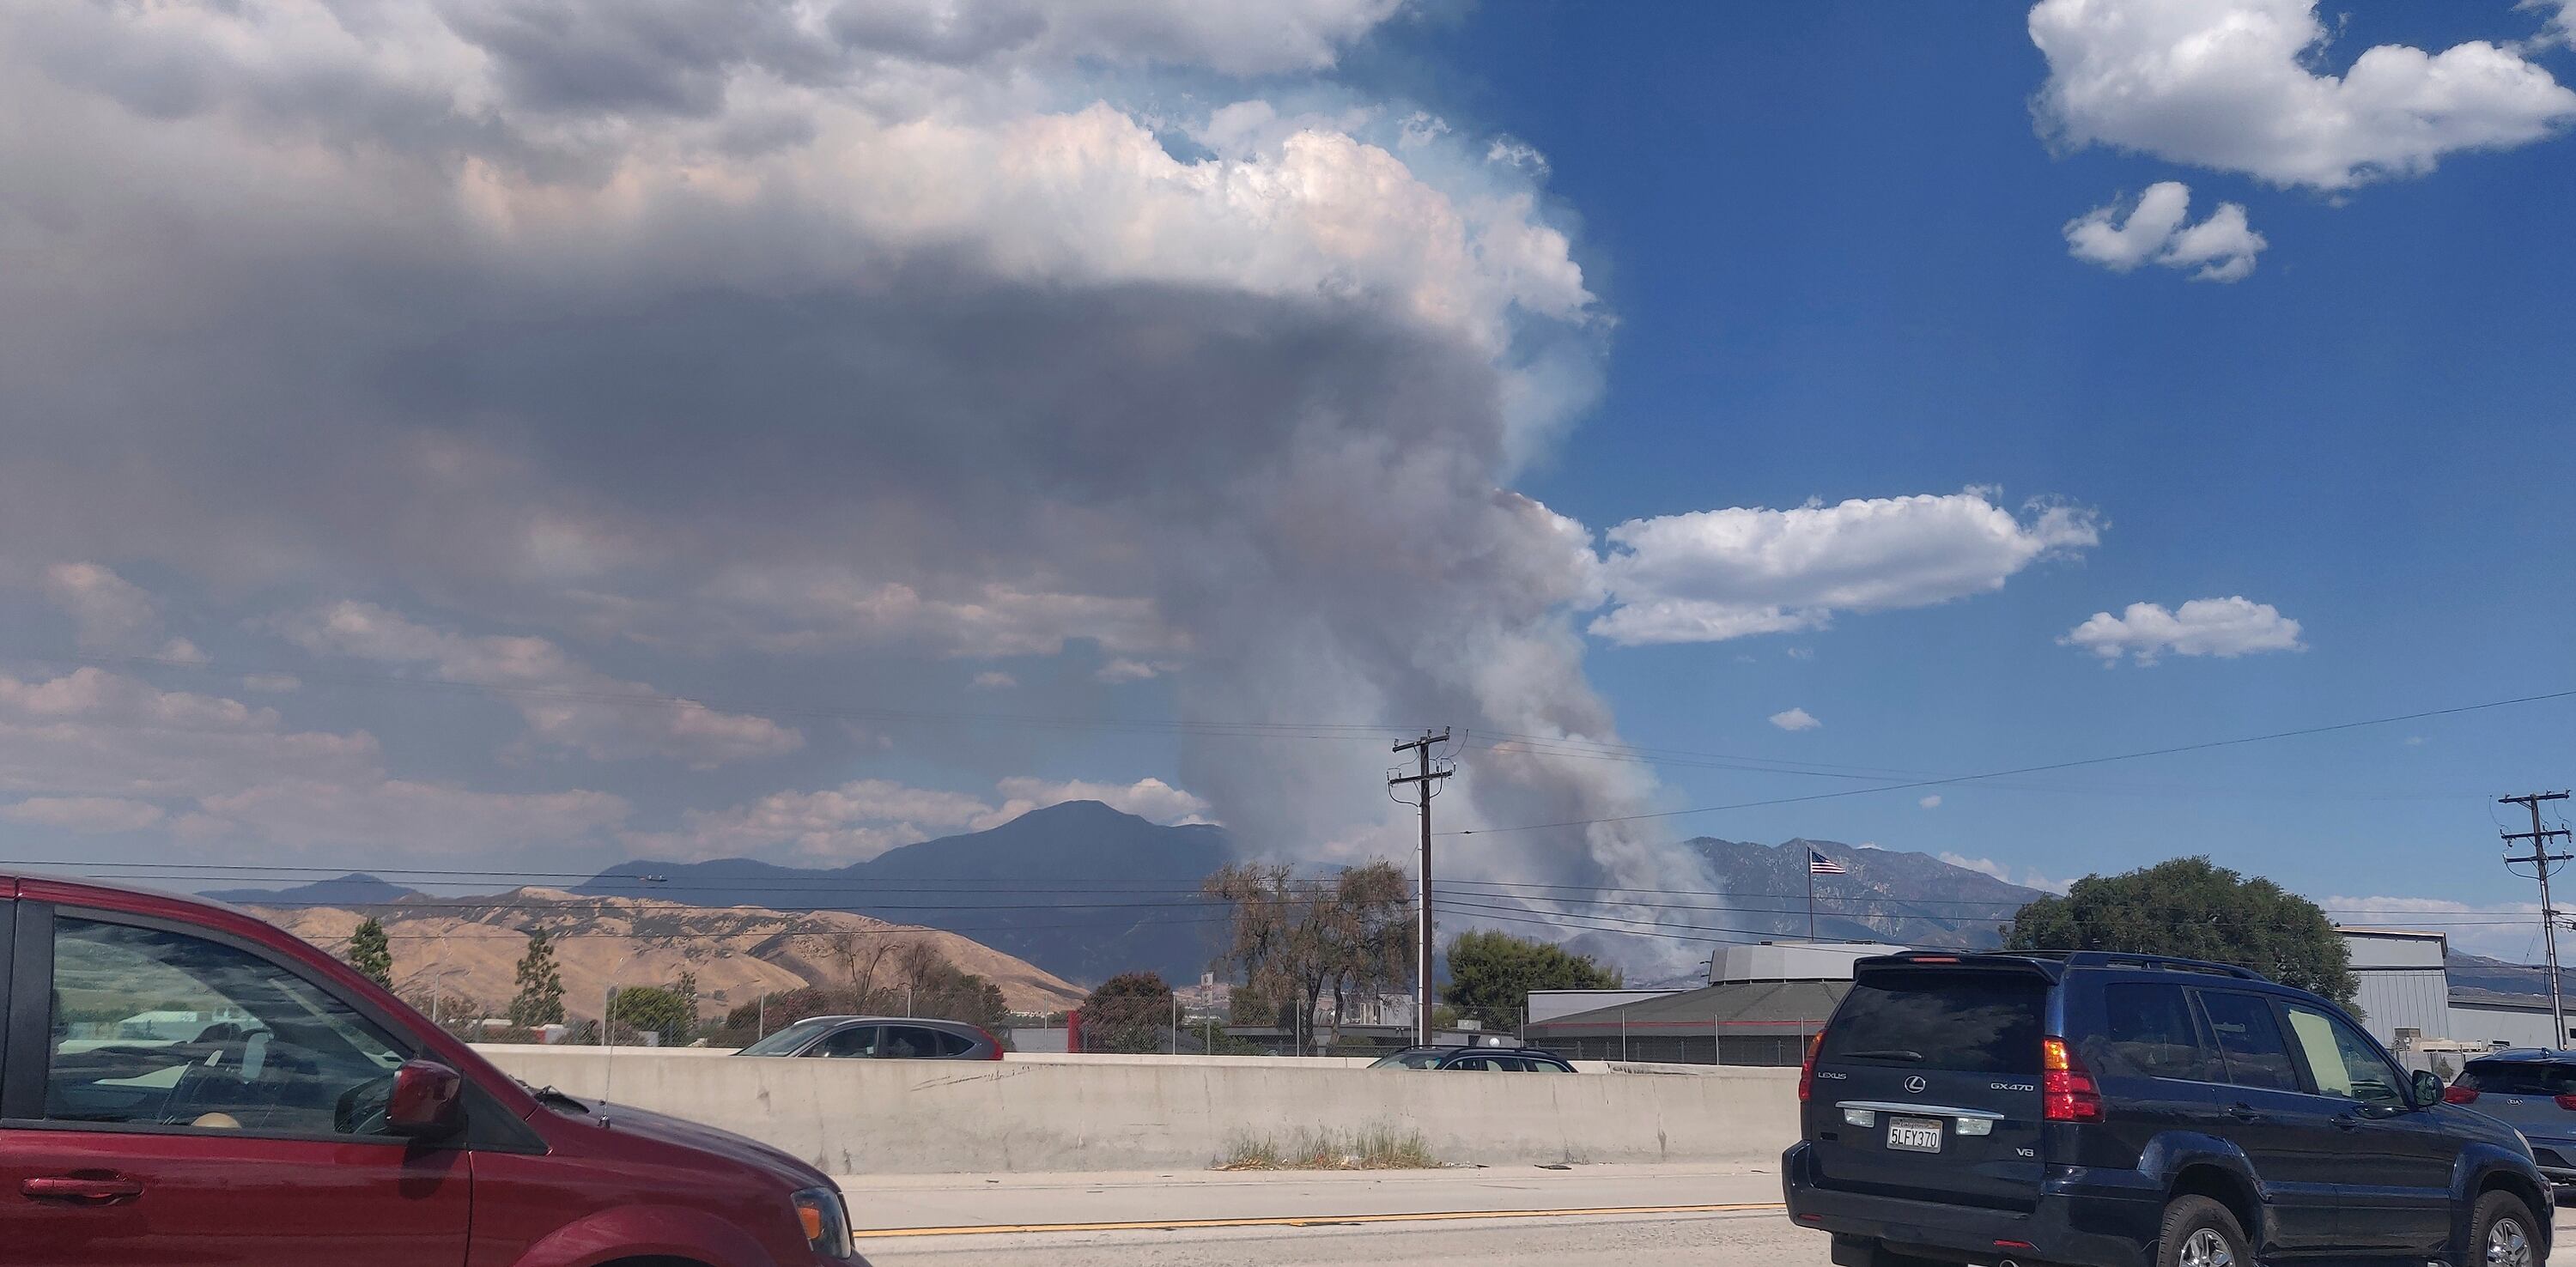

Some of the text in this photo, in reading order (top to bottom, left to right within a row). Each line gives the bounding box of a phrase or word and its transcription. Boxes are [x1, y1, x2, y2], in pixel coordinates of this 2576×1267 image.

[1818, 1071, 1847, 1080] LEXUS
[1892, 1129, 1937, 1147] 5LFY370
[2015, 1148, 2034, 1157] V8
